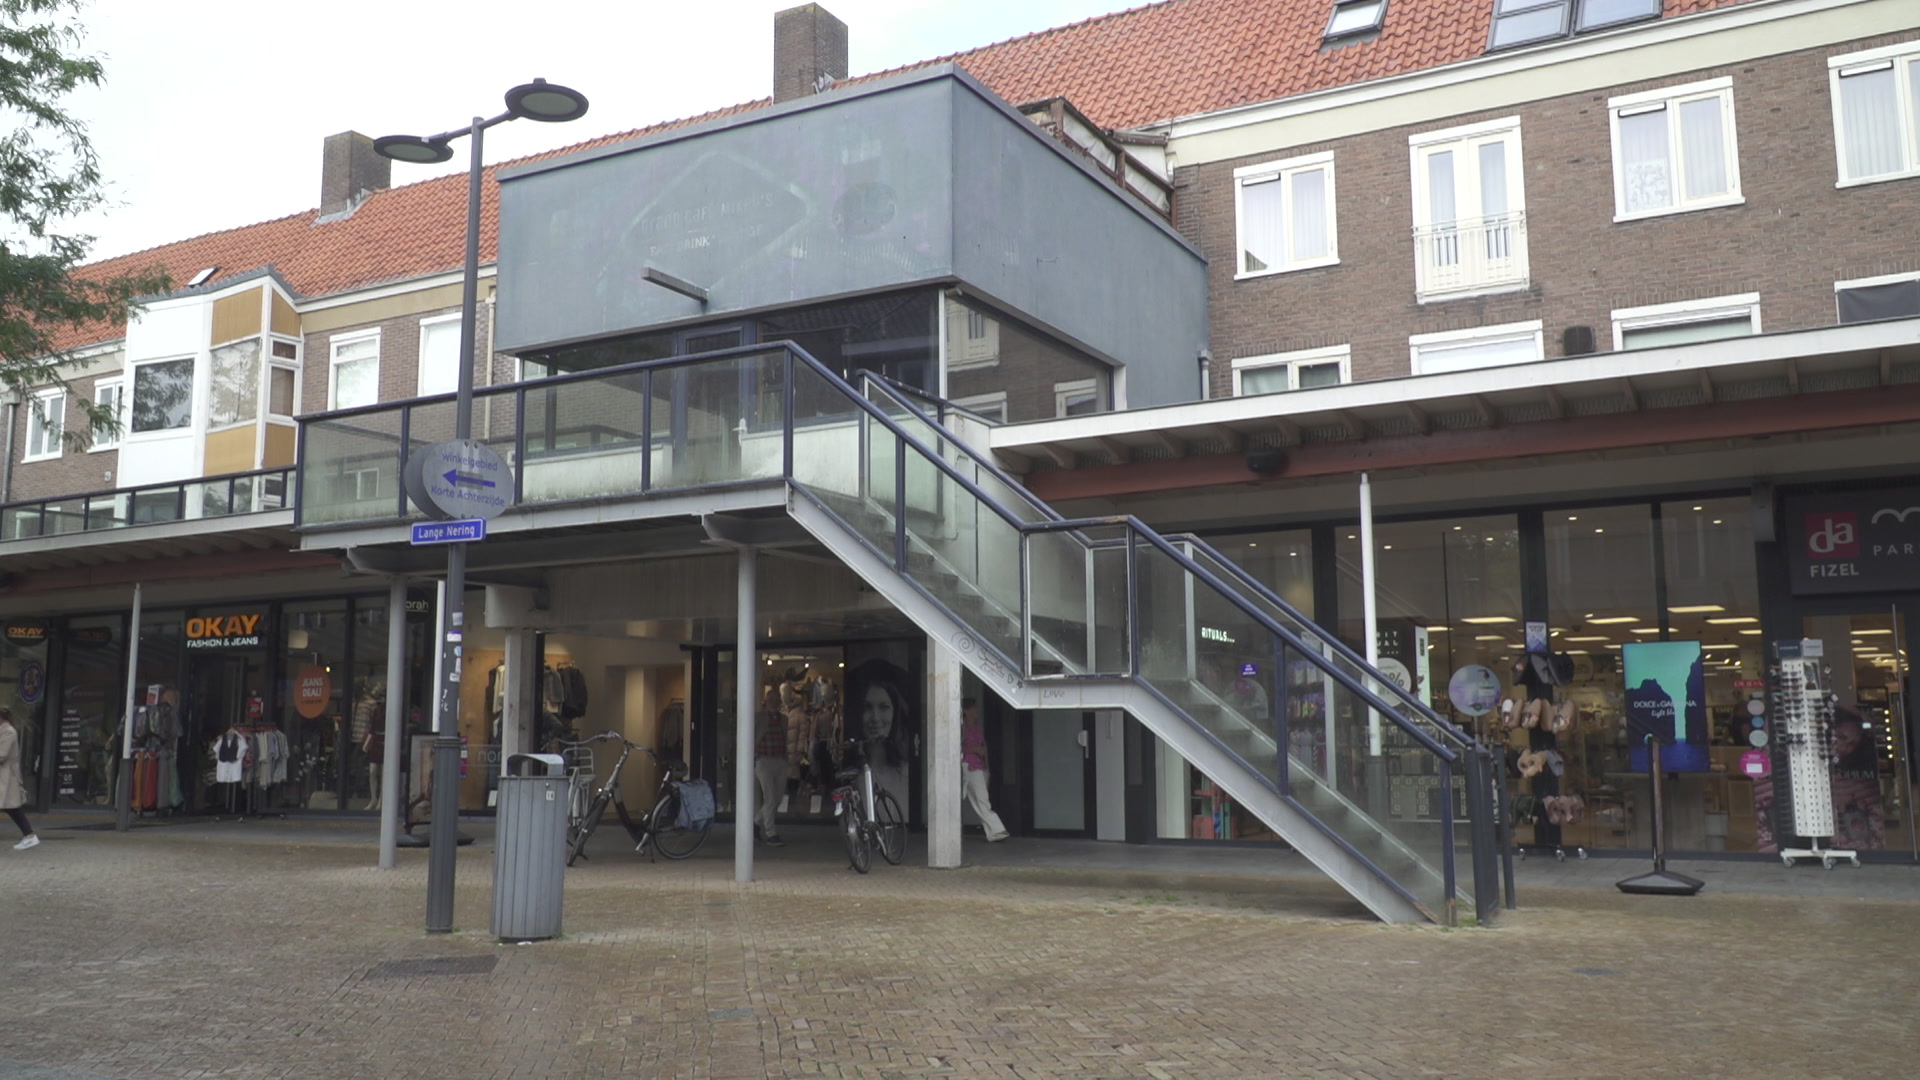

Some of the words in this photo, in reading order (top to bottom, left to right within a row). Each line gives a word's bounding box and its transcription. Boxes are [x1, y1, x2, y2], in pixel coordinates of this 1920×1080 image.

[431, 485, 455, 498] Korte
[457, 489, 505, 507] Achterzijde
[418, 527, 444, 539] Lange
[446, 525, 475, 538] Nering
[1809, 519, 1854, 553] da
[1873, 542, 1919, 556] PAR
[1810, 563, 1859, 578] FIZEL
[405, 599, 429, 609] orah
[8, 626, 44, 635] OKAY
[186, 613, 260, 638] OKAY
[186, 638, 222, 649] FASHION
[224, 637, 229, 647] &
[231, 636, 259, 646] JEANS
[302, 677, 323, 687] JEANS
